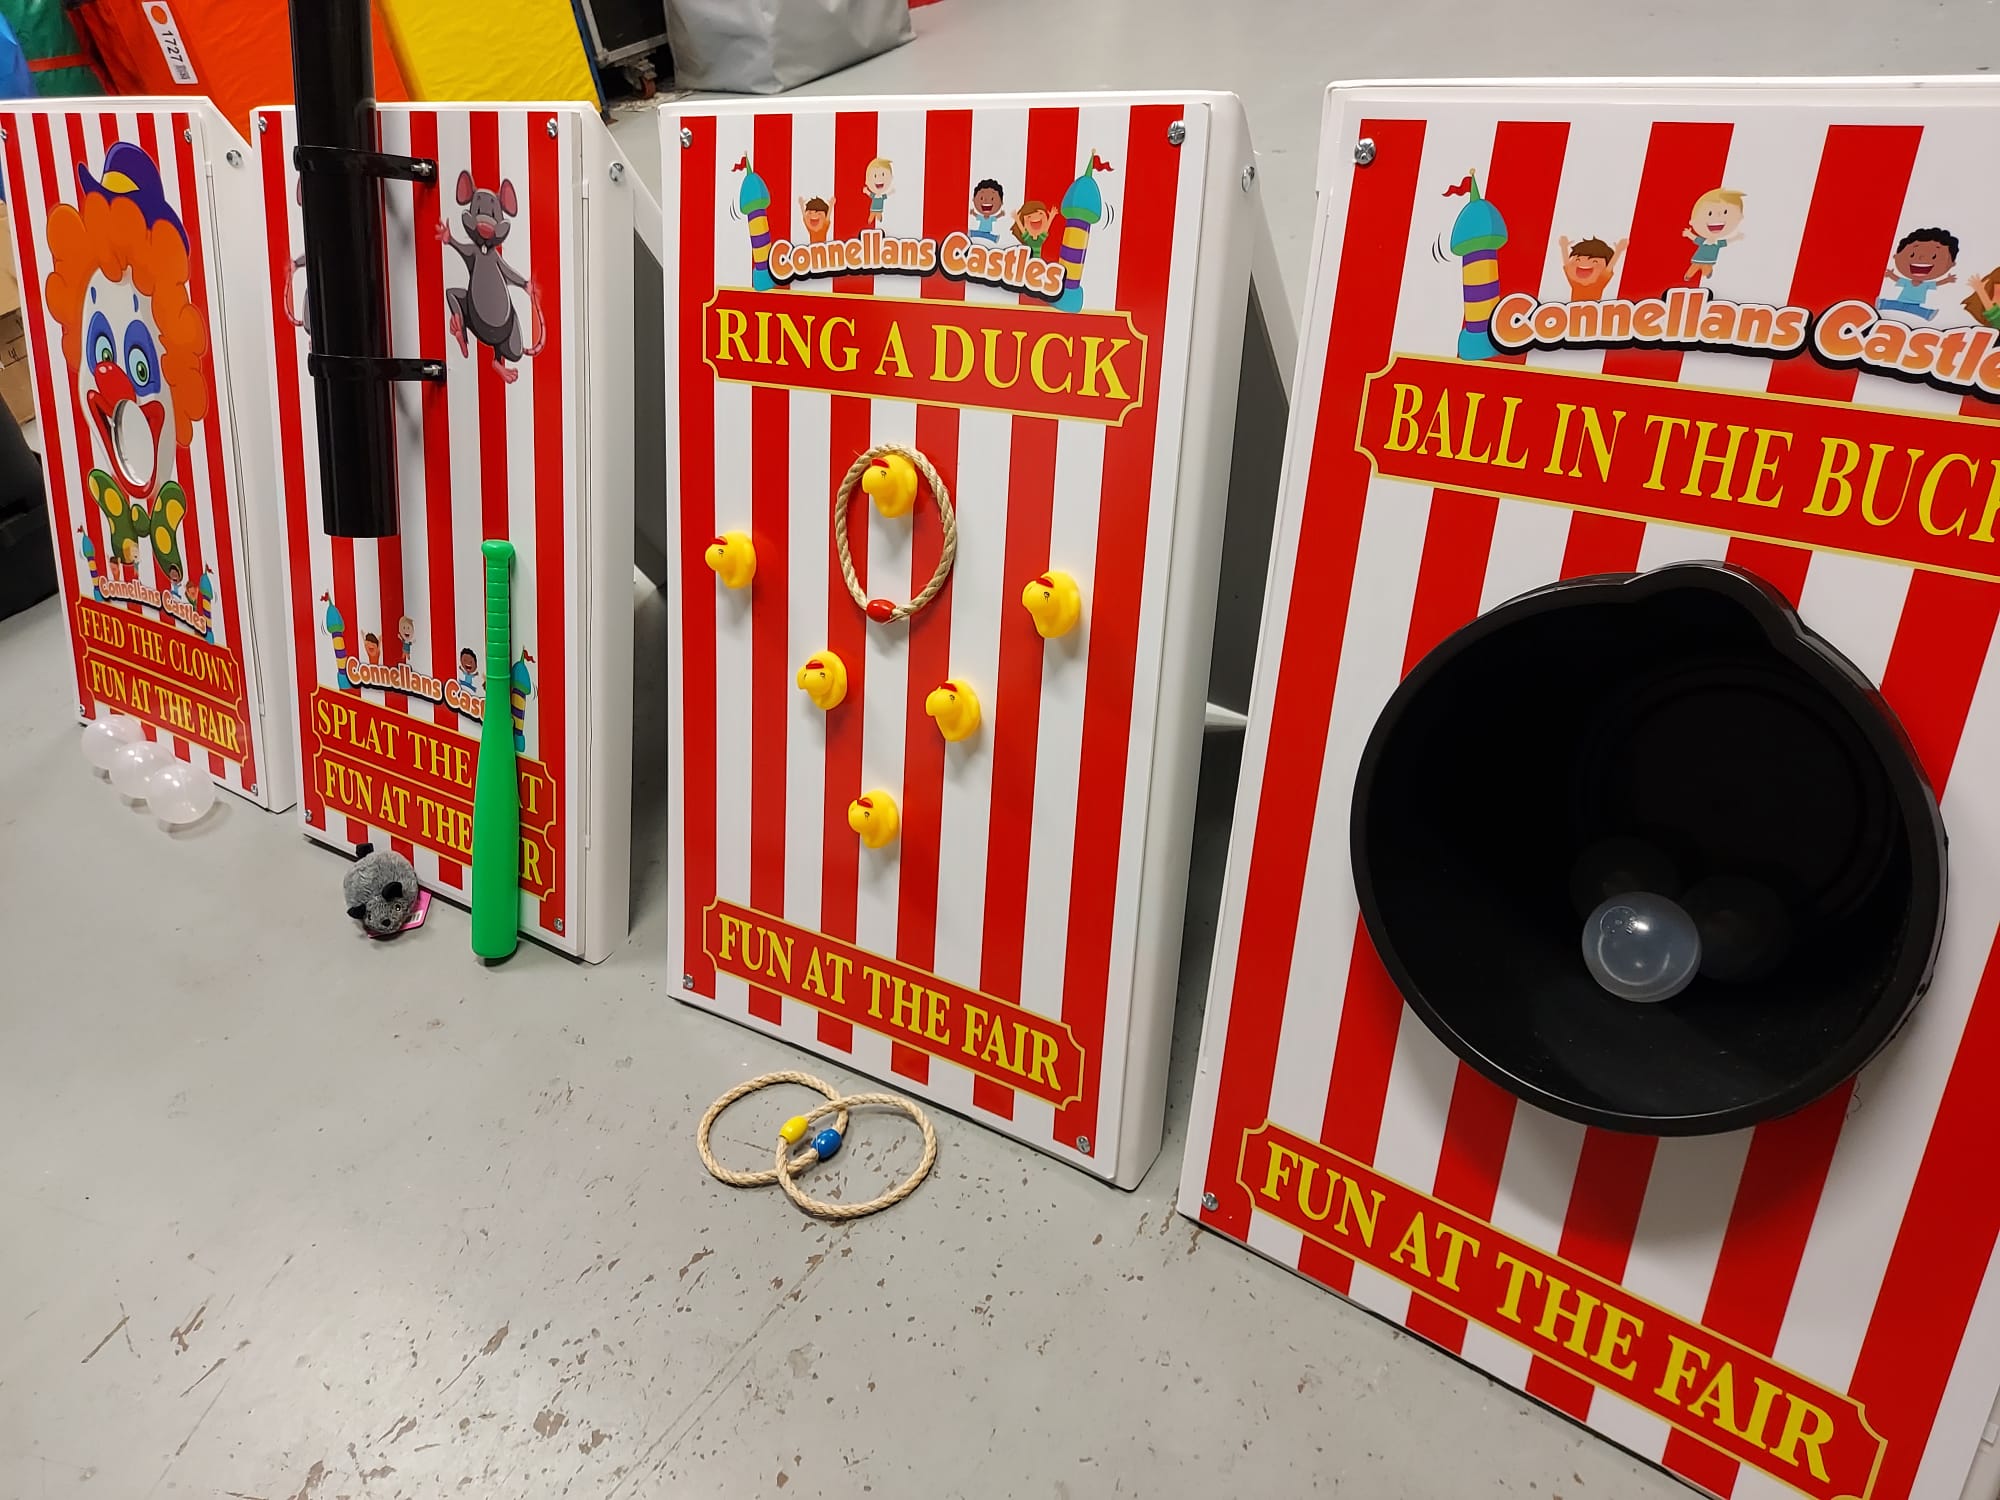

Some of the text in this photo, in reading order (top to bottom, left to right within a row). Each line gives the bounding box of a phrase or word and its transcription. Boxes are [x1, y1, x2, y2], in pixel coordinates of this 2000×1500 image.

[162, 30, 183, 62] 1727
[770, 231, 1064, 295] Connellans Castles
[715, 307, 1131, 401] RING A DUCK
[1492, 290, 1808, 348] Connellans
[1383, 383, 1530, 470] BALL
[1543, 403, 1626, 484] IN
[1642, 415, 1795, 509] THE
[100, 577, 207, 632] Connellans Castles
[81, 606, 235, 694] FEED THE CLOWN
[347, 658, 442, 698] Connellans
[90, 660, 241, 754] FUN AT THE FAIR
[317, 699, 473, 789] SPLAT THE
[324, 759, 473, 855] FUN AT THE
[718, 913, 1062, 1092] FUN AT THE FAIR
[1260, 1140, 1835, 1485] FUN AT THE FAIR
